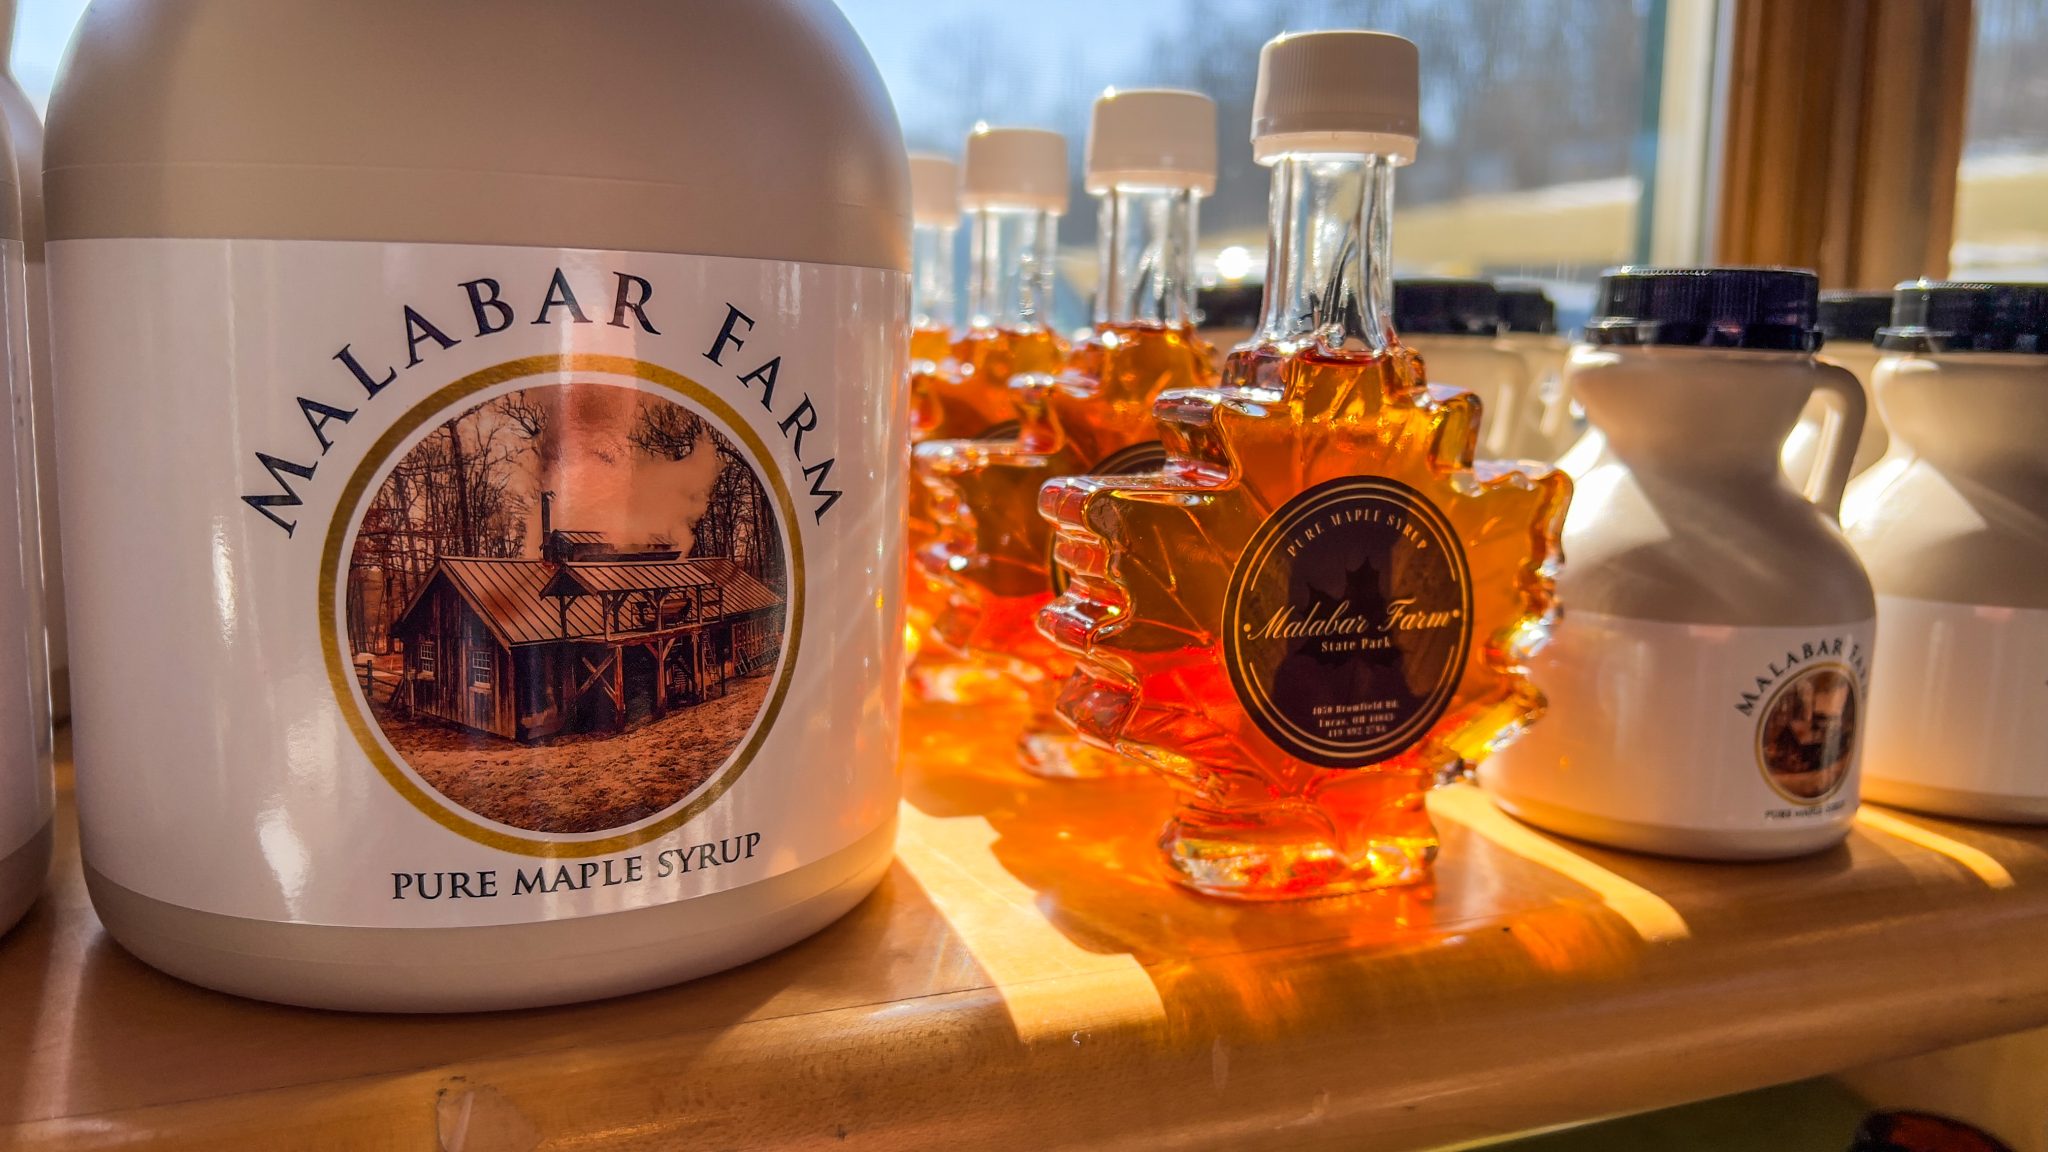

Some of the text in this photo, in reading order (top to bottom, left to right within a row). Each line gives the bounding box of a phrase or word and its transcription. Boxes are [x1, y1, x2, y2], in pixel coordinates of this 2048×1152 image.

[241, 267, 843, 538] MALABAR FARM
[1287, 509, 1428, 557] PURE MAPLE SYRUP
[1247, 597, 1450, 641] Malabar Farm
[1321, 635, 1392, 652] State Park
[1735, 637, 1843, 718] MALABAR
[392, 832, 762, 900] PURE MAPLE SYRUP
